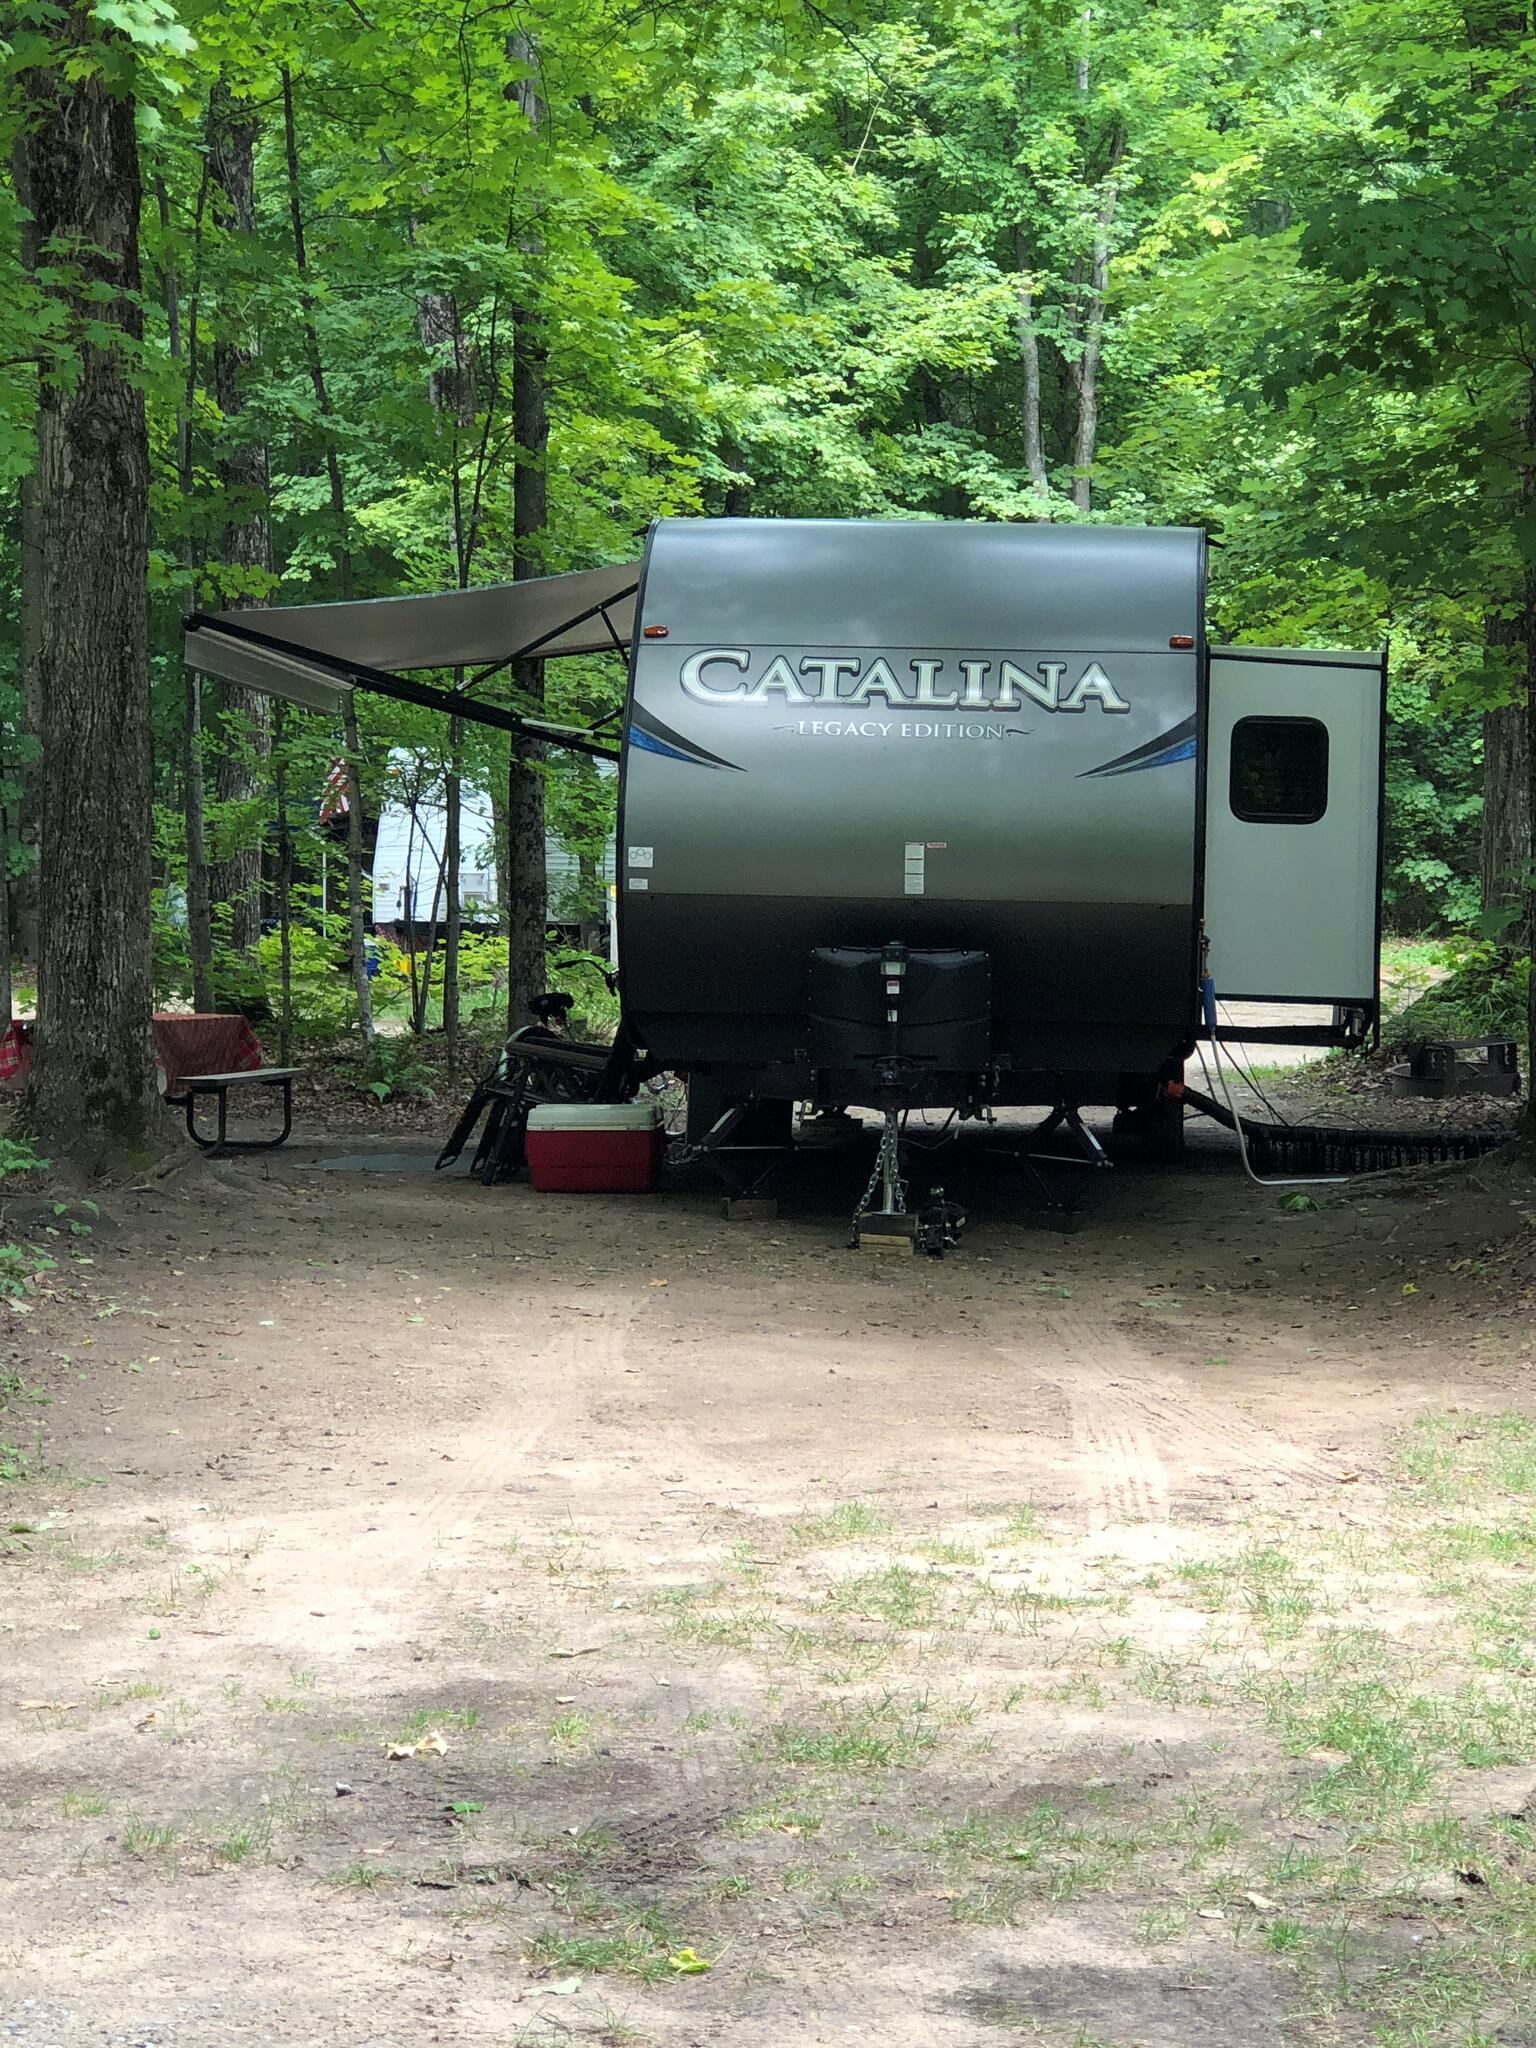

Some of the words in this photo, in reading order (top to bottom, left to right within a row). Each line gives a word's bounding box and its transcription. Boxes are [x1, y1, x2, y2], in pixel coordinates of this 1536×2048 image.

[679, 648, 1131, 713] CATALINA
[797, 720, 894, 738] LEGACY
[900, 723, 1004, 741] EDITION
